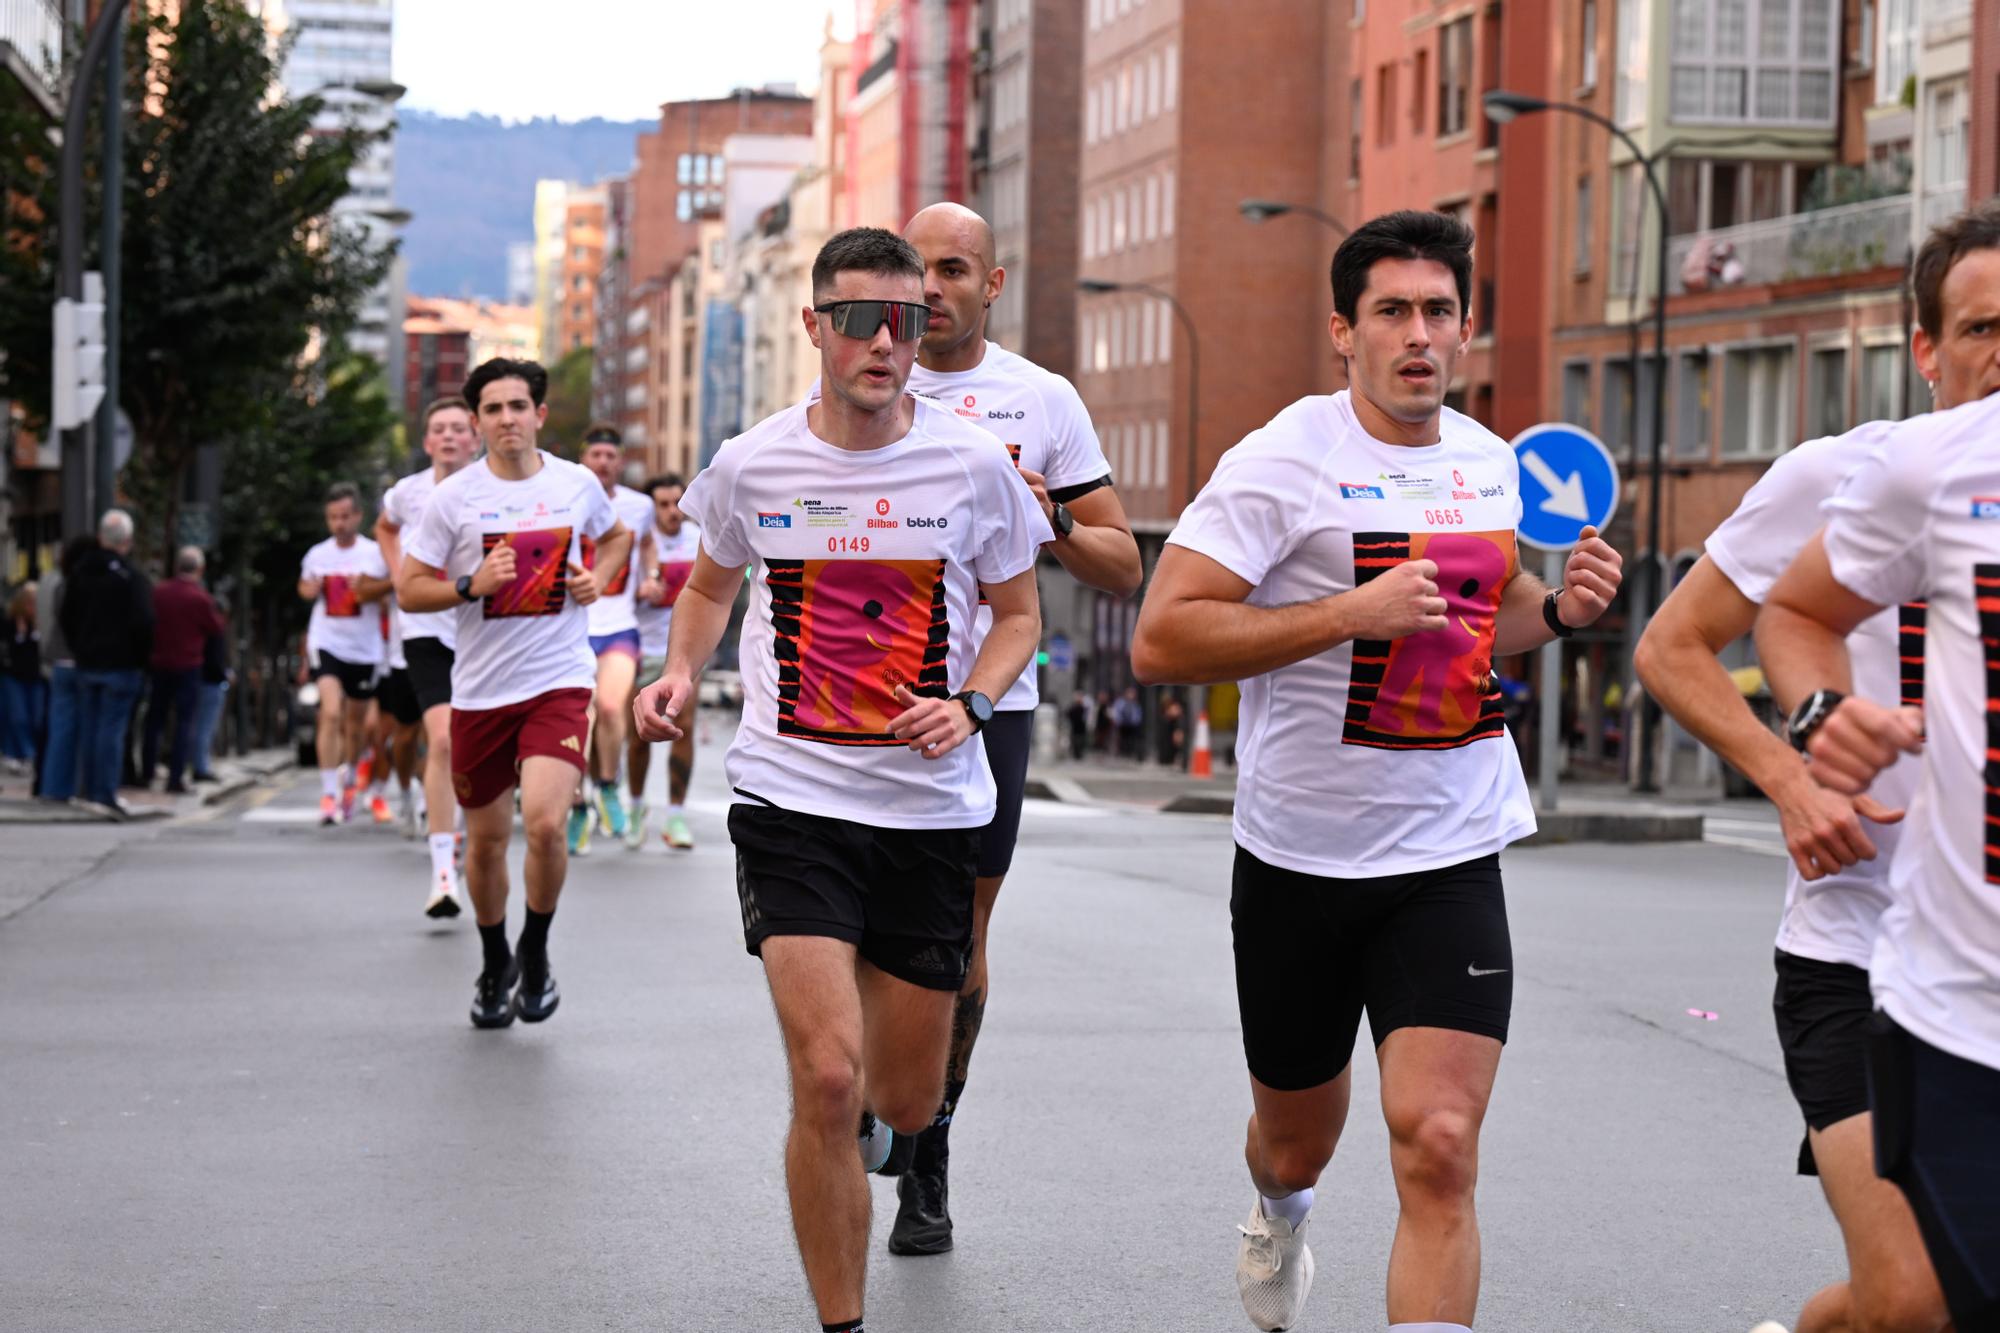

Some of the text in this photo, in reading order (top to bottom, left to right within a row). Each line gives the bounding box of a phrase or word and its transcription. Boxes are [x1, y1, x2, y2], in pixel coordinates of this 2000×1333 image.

[988, 410, 1012, 419] bbk
[1347, 487, 1376, 498] Deia
[1451, 490, 1476, 500] Bilbao
[1478, 486, 1500, 497] bbk
[763, 516, 785, 528] Deia
[1425, 508, 1464, 525] 0665
[867, 519, 898, 529] Bilbao
[907, 517, 936, 528] bbk
[828, 536, 870, 553] 0149
